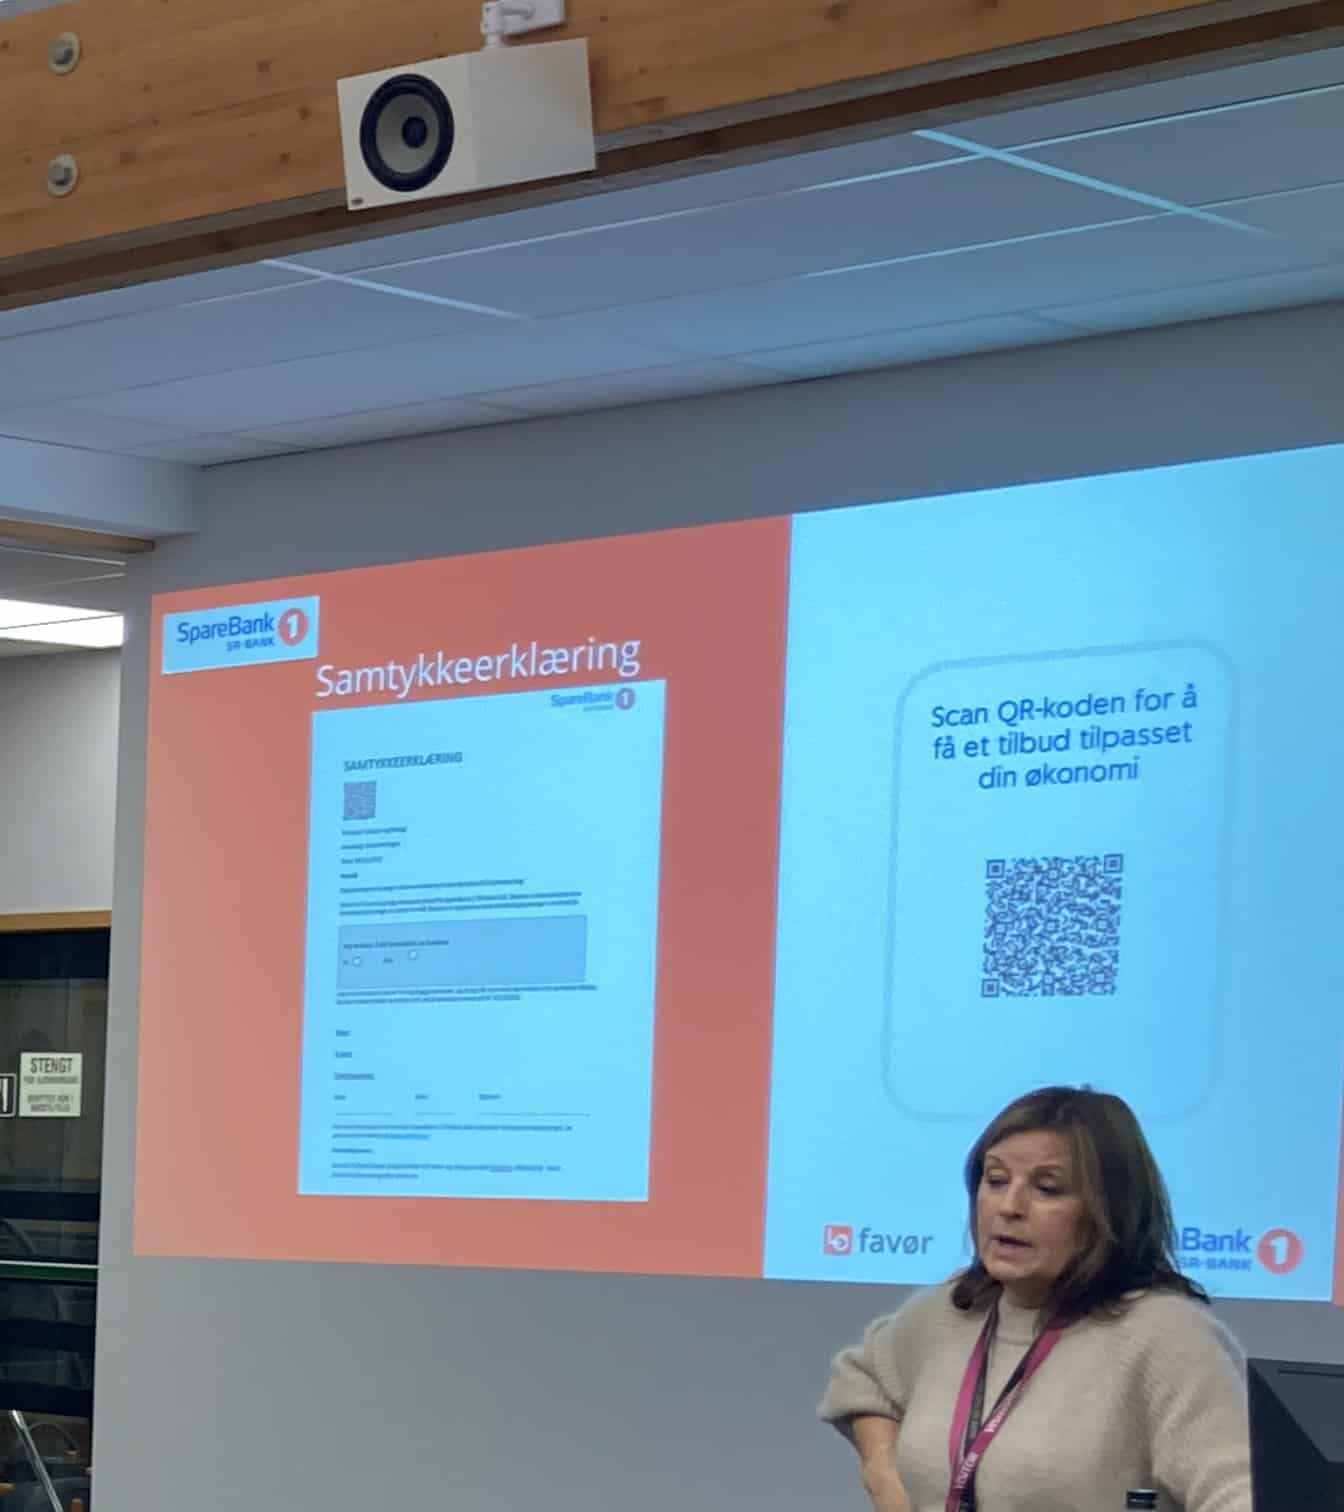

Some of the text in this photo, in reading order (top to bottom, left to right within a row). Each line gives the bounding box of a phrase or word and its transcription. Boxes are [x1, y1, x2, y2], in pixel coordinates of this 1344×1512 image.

[177, 613, 275, 644] SpareBank
[315, 637, 641, 699] Samtykkeerklæring
[931, 683, 1198, 729] Scan QR-koden for å
[933, 721, 1193, 760] få et tilbud tilpasset
[978, 756, 1140, 790] din økonomi
[30, 1057, 73, 1073] STENGT
[859, 1226, 934, 1255] favør
[1174, 1225, 1252, 1252] Bank
